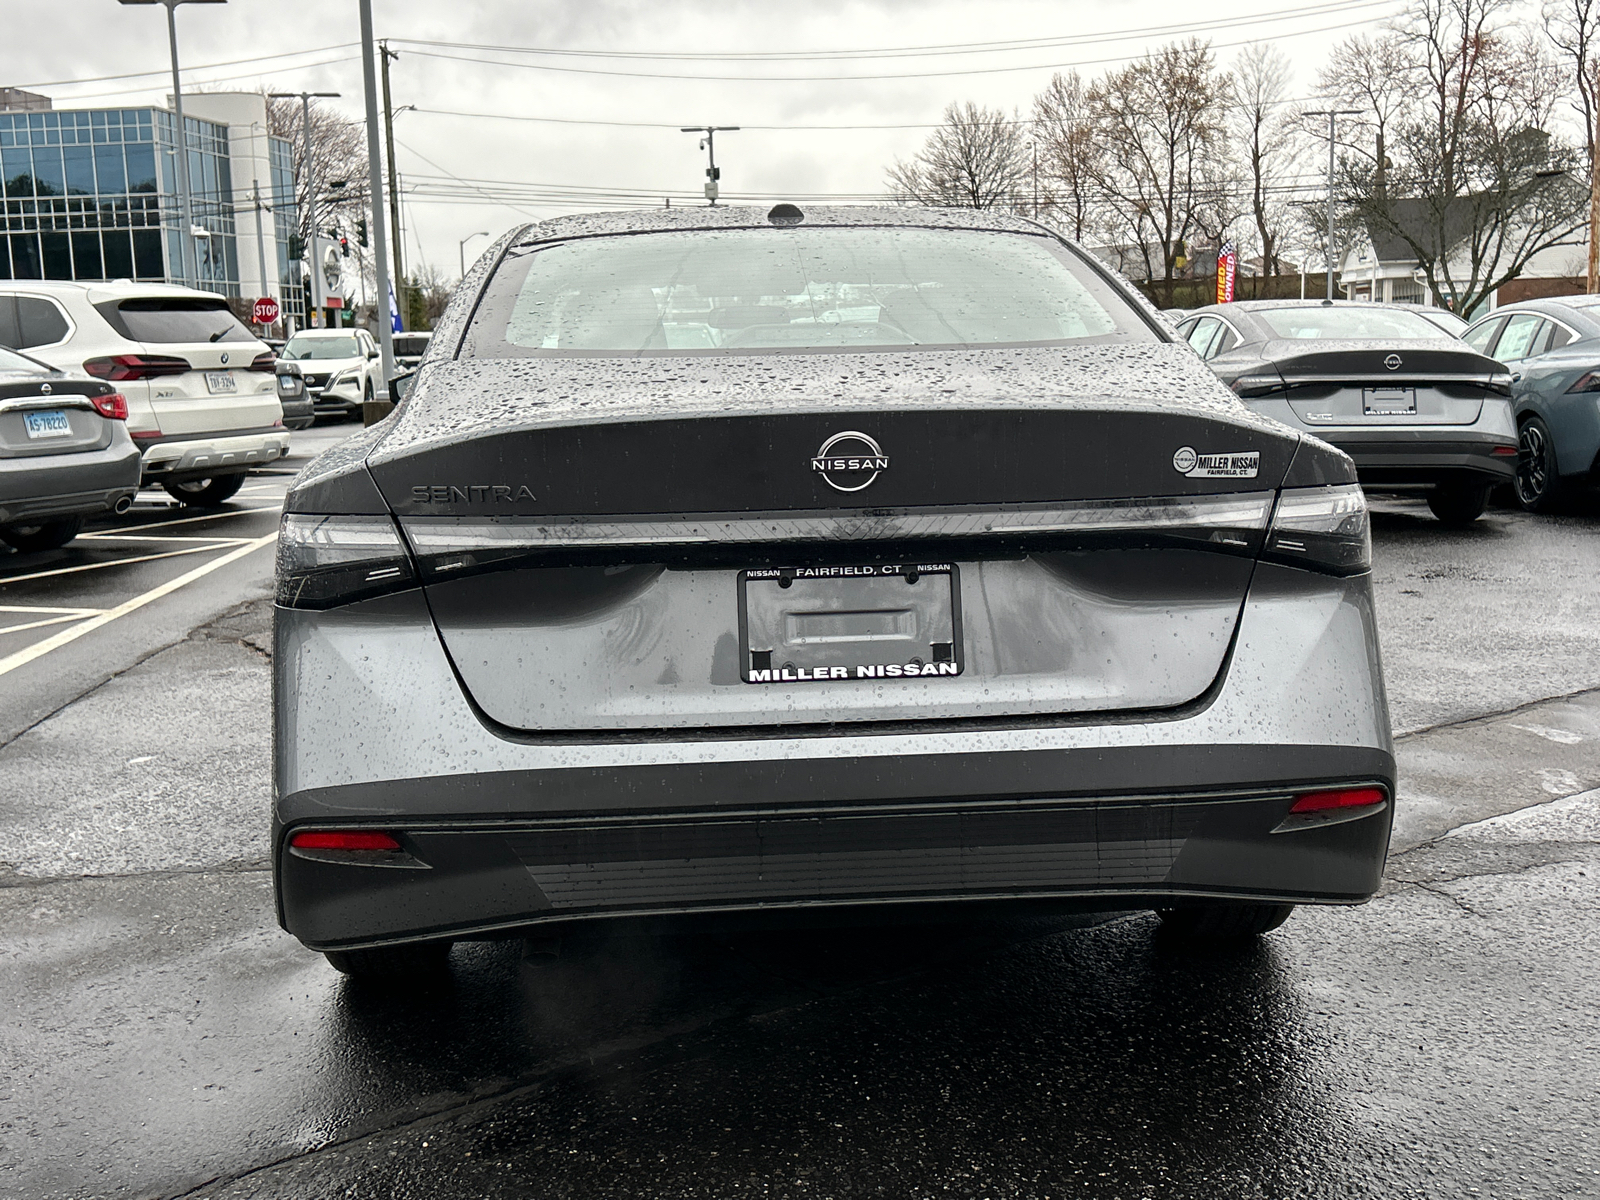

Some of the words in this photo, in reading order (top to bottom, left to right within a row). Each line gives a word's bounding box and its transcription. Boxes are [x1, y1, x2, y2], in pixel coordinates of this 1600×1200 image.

[1225, 255, 1235, 302] OWNED
[255, 305, 278, 316] STOP
[812, 458, 888, 470] NISSAN
[1198, 457, 1229, 469] MILLER
[1230, 457, 1258, 469] NISSAN
[411, 485, 537, 502] SENTRA
[796, 566, 877, 577] FAIRFIELD,
[881, 565, 902, 574] CT
[917, 564, 950, 572] NISSAN
[749, 667, 848, 682] MILLER
[857, 663, 958, 678] NISSAN
